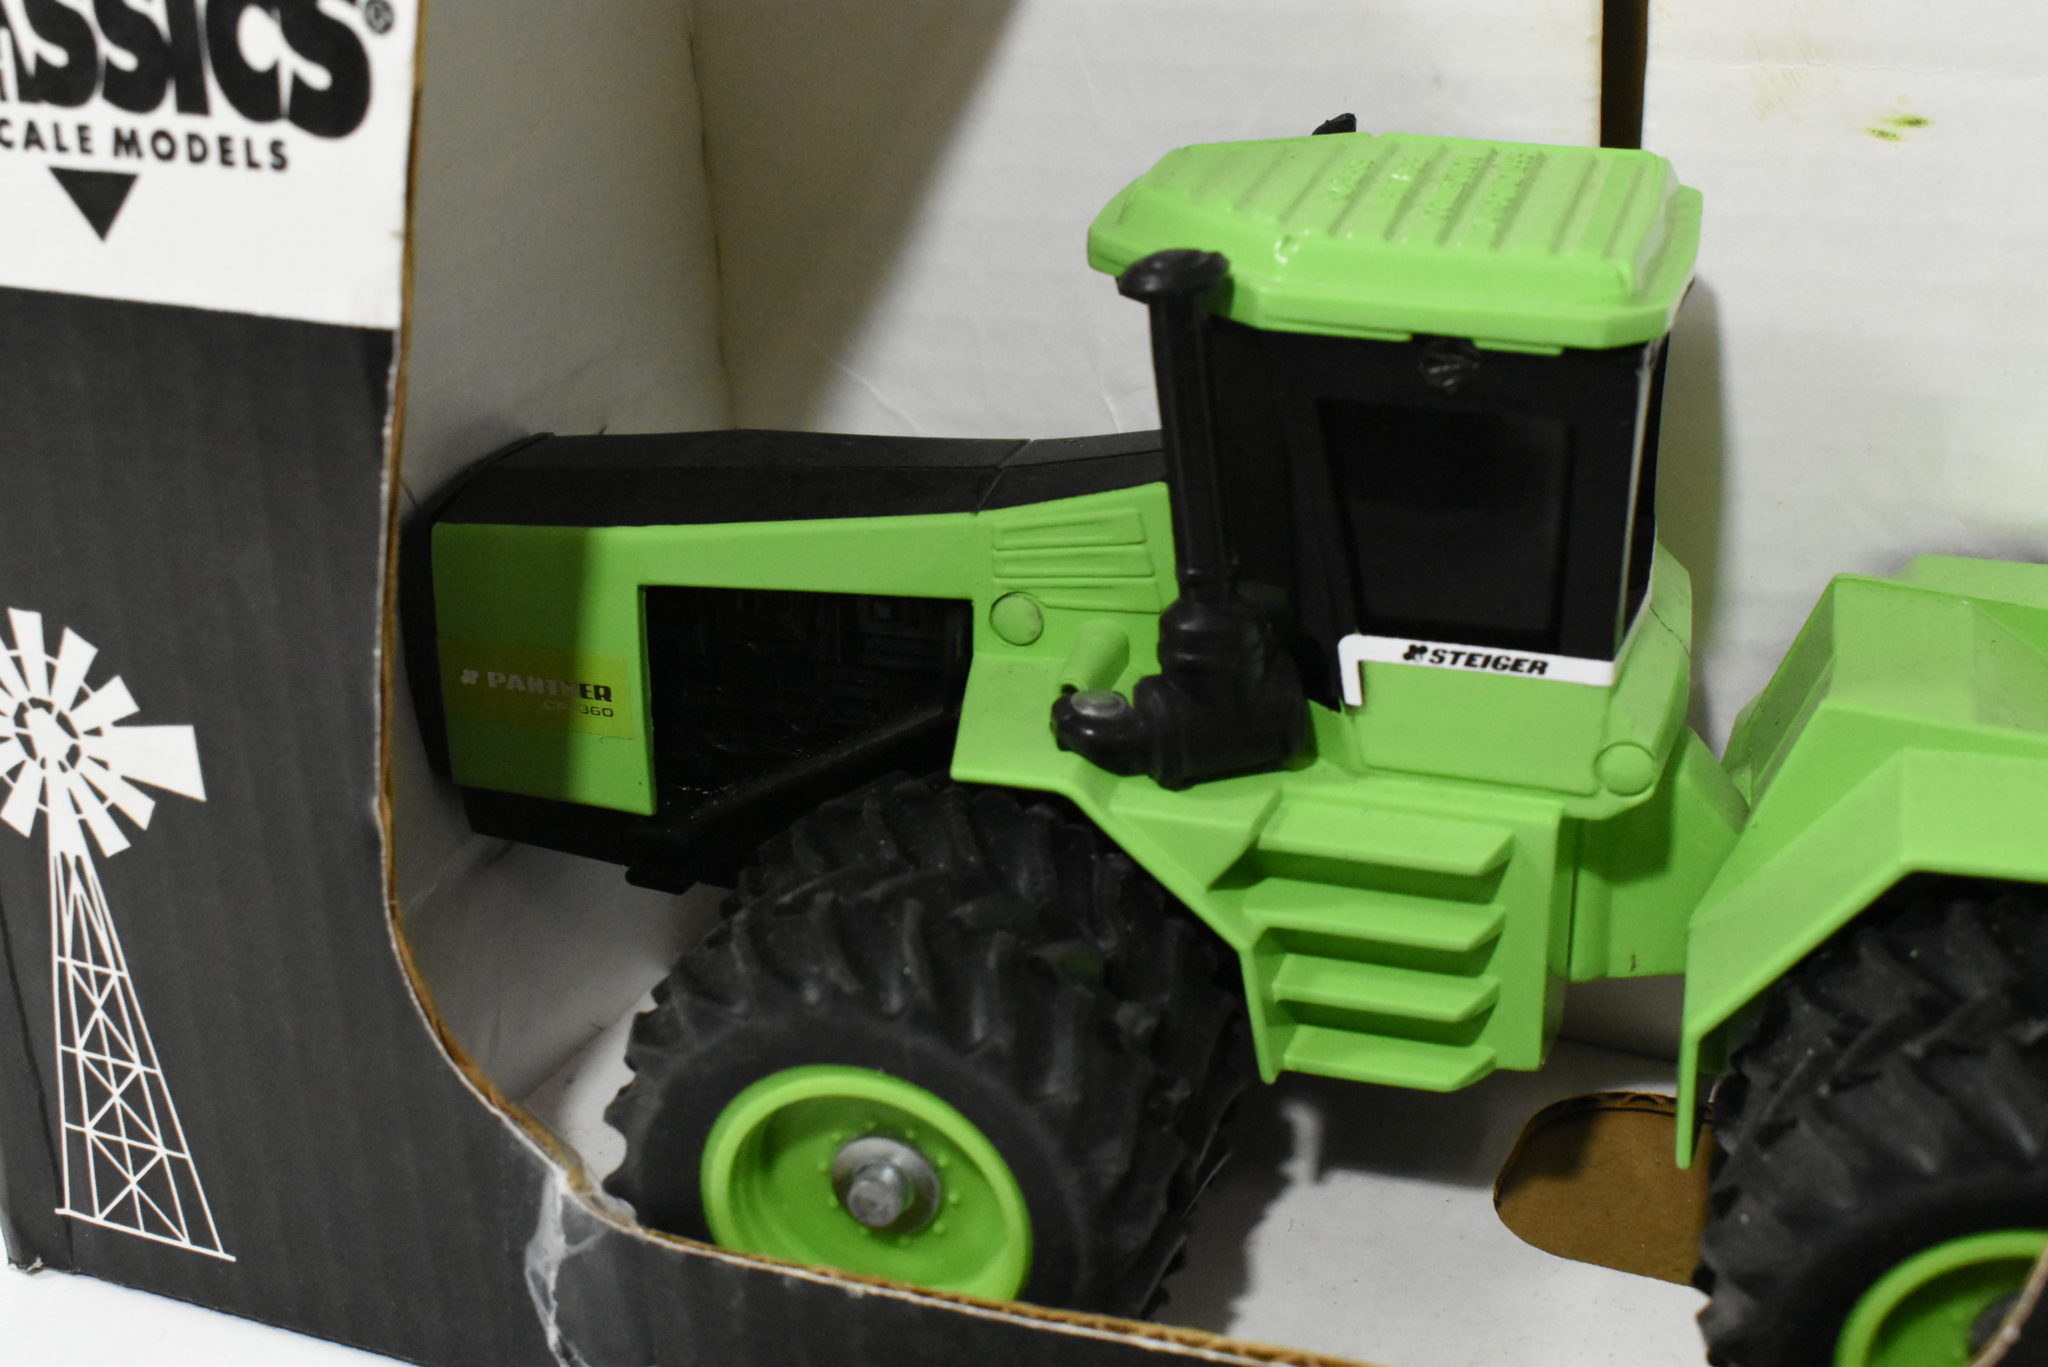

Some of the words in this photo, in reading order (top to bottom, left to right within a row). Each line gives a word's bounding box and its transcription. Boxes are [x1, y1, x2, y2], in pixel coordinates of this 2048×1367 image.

[113, 126, 289, 171] MODELS
[1429, 648, 1549, 676] STEIGER
[487, 671, 613, 702] PANTHER
